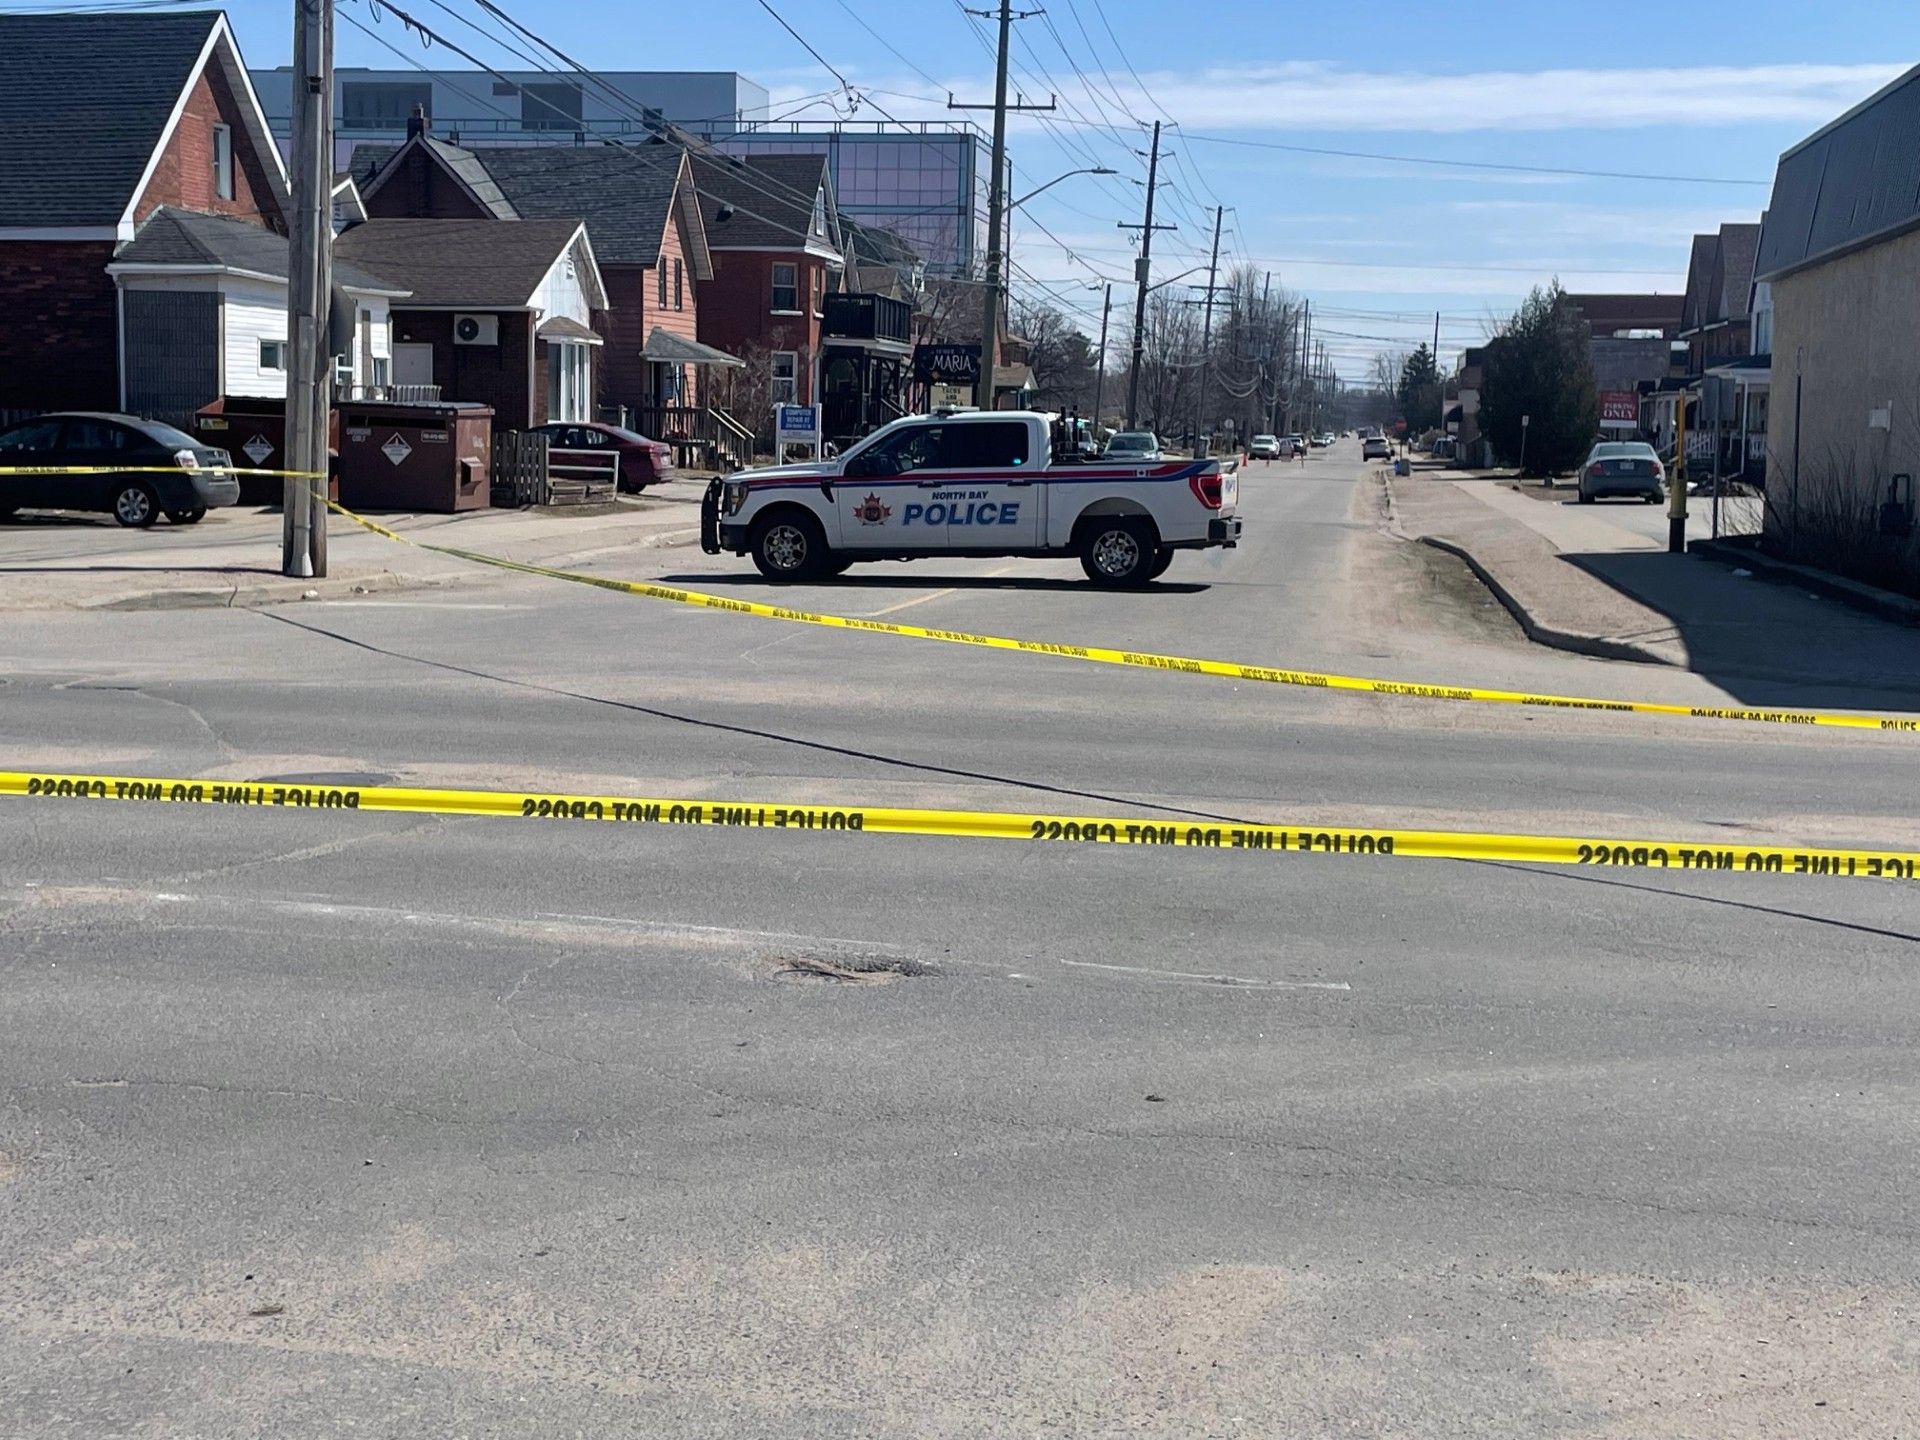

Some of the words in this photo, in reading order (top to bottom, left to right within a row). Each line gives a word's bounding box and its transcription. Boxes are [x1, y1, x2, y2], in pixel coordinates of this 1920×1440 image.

[930, 355, 976, 373] MARIA
[1604, 402, 1636, 410] PARKING
[1603, 409, 1633, 419] ONLY
[932, 491, 966, 500] NORTH
[969, 490, 989, 499] BAY
[903, 502, 1021, 526] POLICE
